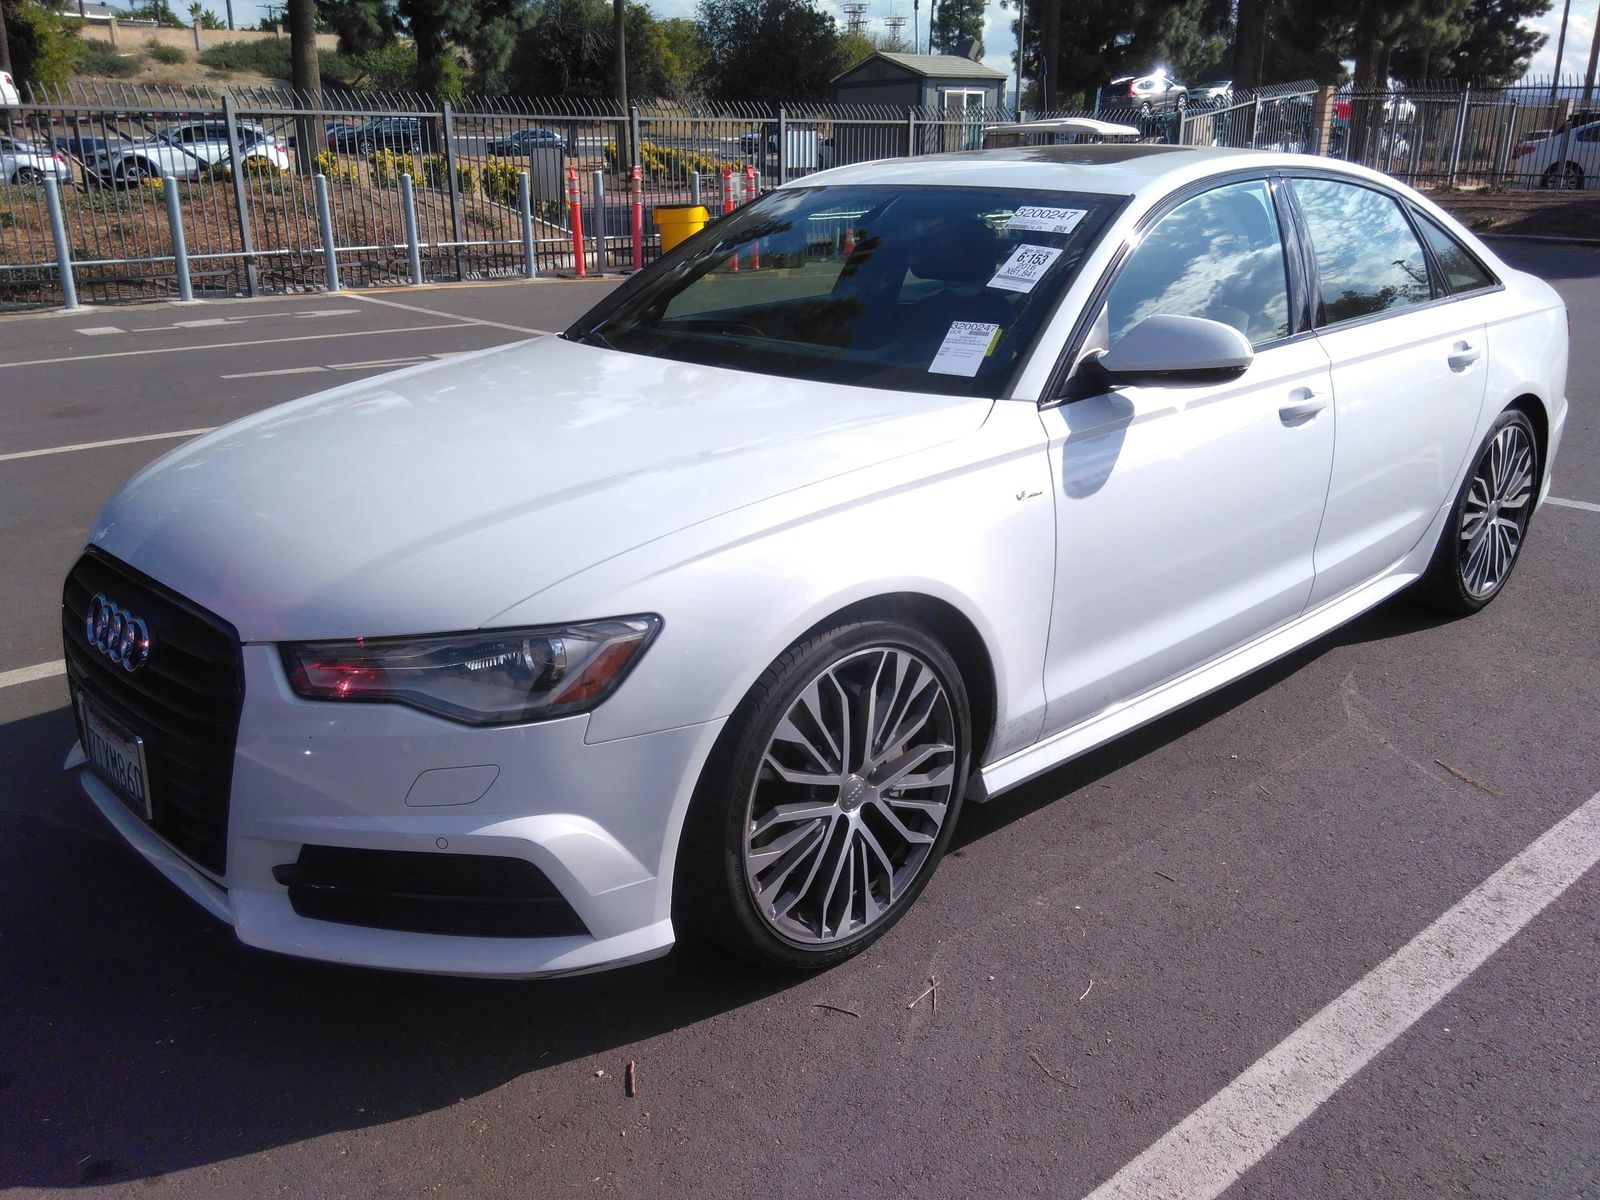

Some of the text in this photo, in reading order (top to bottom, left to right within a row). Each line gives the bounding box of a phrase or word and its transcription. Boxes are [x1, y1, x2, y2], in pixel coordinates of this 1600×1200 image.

[1014, 207, 1078, 220] 3200247
[1017, 252, 1049, 265] 6:153
[951, 322, 998, 332] 3200247
